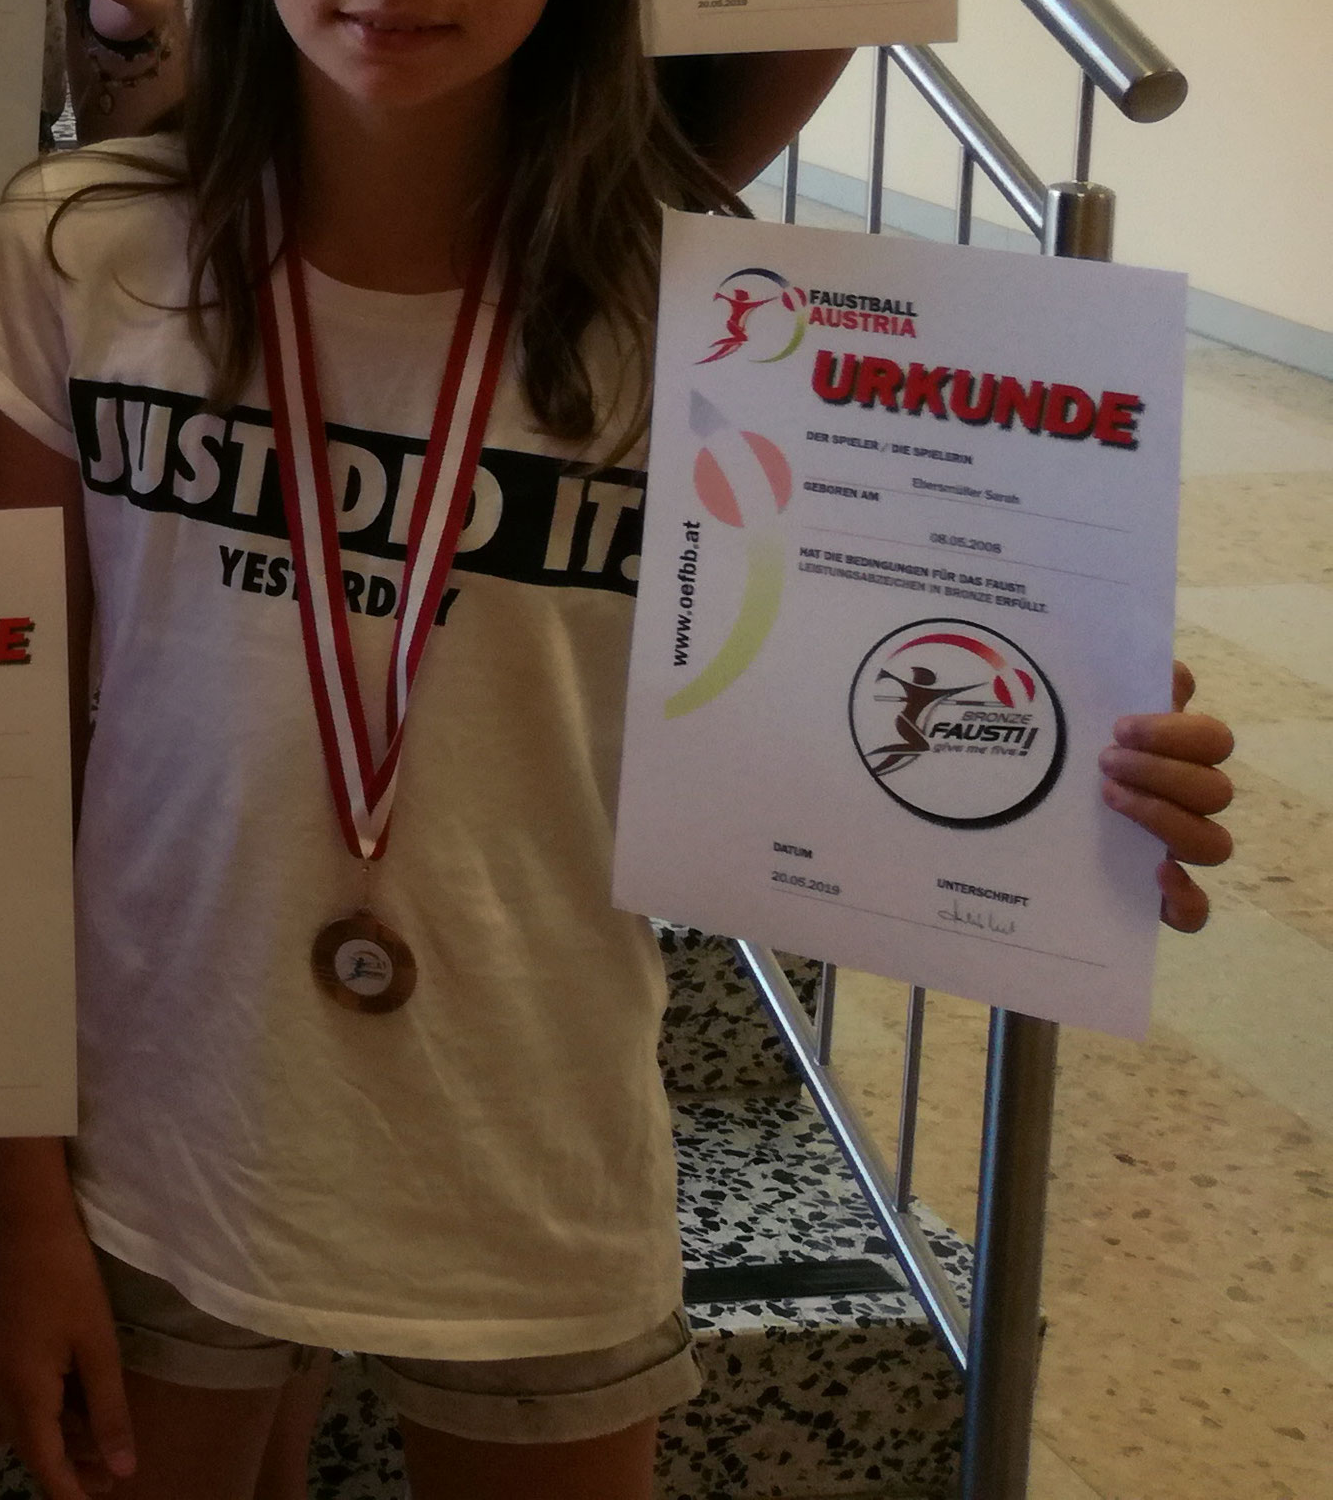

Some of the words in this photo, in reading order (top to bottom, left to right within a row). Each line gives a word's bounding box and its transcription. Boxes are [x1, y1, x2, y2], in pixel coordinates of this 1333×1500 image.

[808, 289, 918, 318] FAUSTBALL
[808, 310, 917, 338] AUSTRIA
[811, 350, 1141, 449] URKUNDE
[89, 397, 278, 517] JUST
[806, 430, 829, 443] DER
[832, 434, 879, 451] SPIELER
[891, 443, 911, 455] DIE
[803, 481, 858, 499] GEBOREN
[860, 490, 880, 501] AM
[799, 546, 823, 560] HAT
[823, 550, 843, 563] DIE
[845, 553, 929, 577] BEDINGUNGEN
[932, 567, 957, 582] FÜR
[959, 573, 983, 586] DAS
[673, 520, 701, 667] www.oefbb.at
[773, 841, 814, 859] DATUM
[937, 878, 1030, 907] UNTERSCHRIFT
